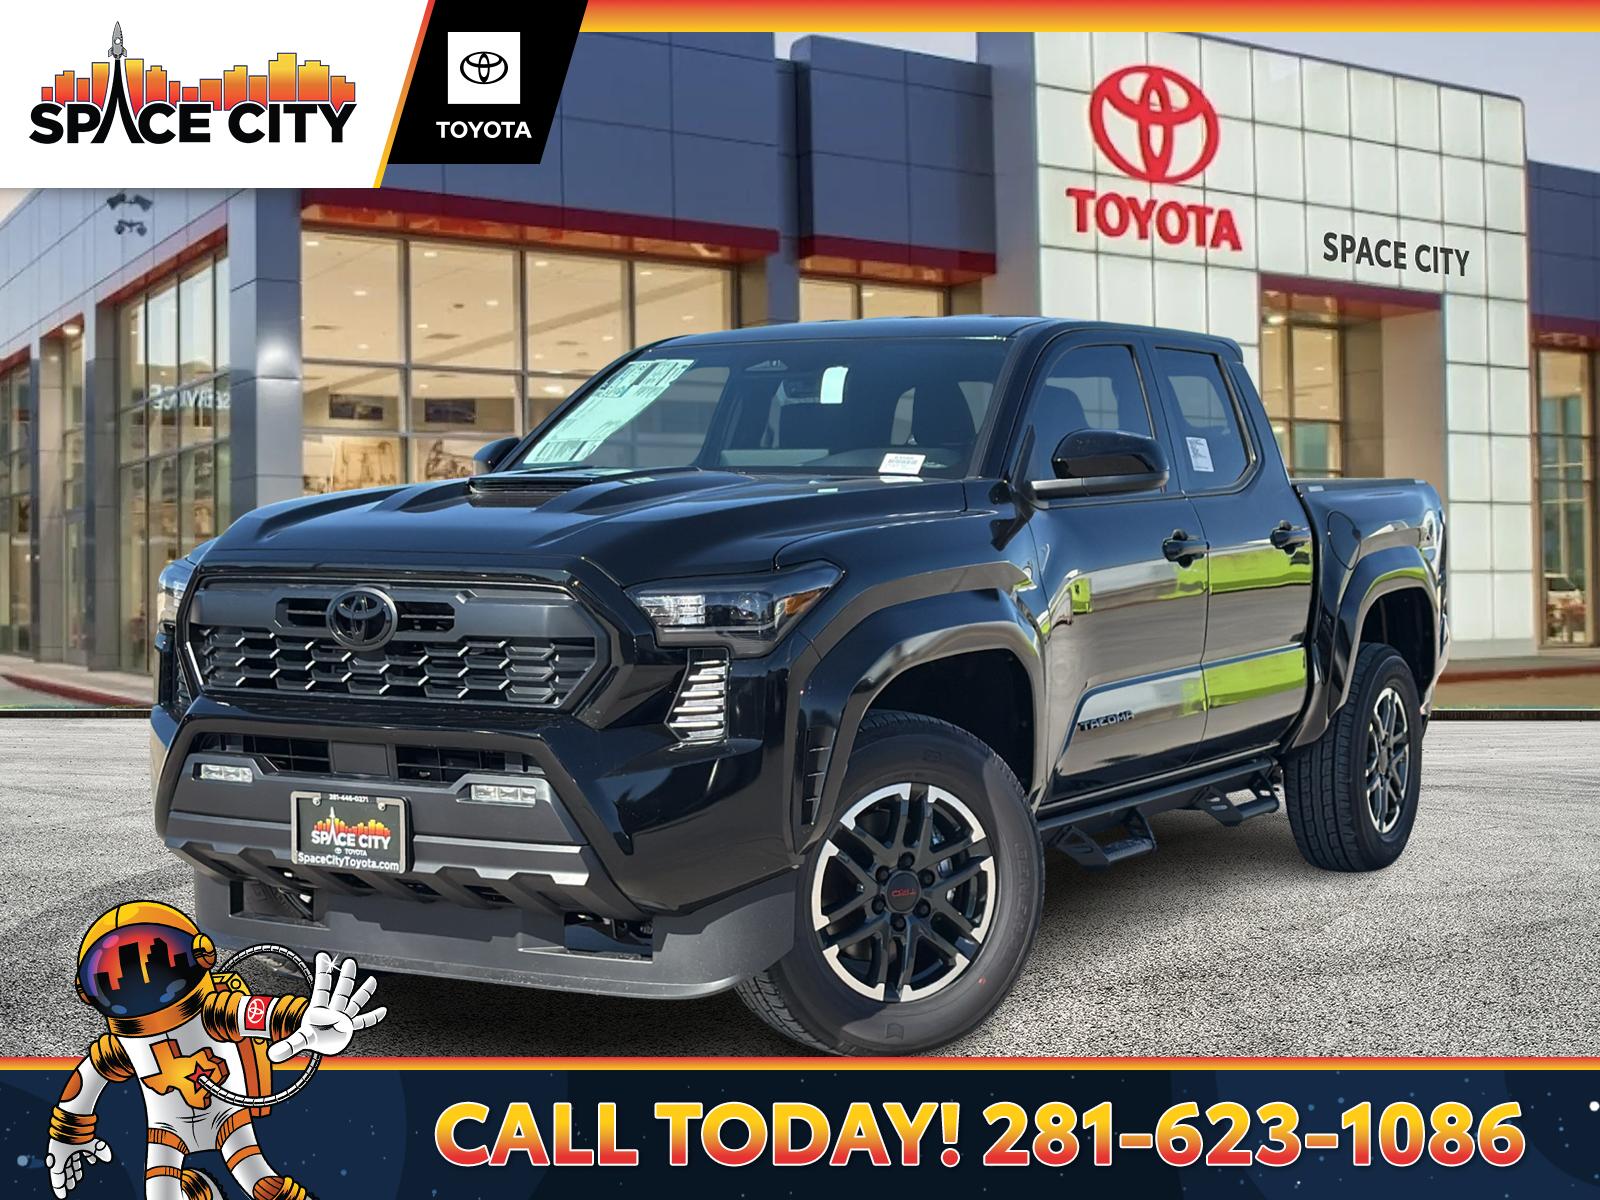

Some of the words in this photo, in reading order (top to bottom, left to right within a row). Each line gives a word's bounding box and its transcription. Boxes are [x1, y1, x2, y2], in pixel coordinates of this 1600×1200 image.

[1066, 188, 1242, 251] TOYOTA
[1323, 232, 1407, 270] SPACE
[1414, 244, 1470, 277] CITY
[1079, 710, 1134, 731] TACOMA
[311, 829, 356, 847] SPACE
[358, 835, 391, 850] CITY
[297, 852, 399, 871] SpaceCityToyota.com
[344, 848, 368, 857] TOYOTA
